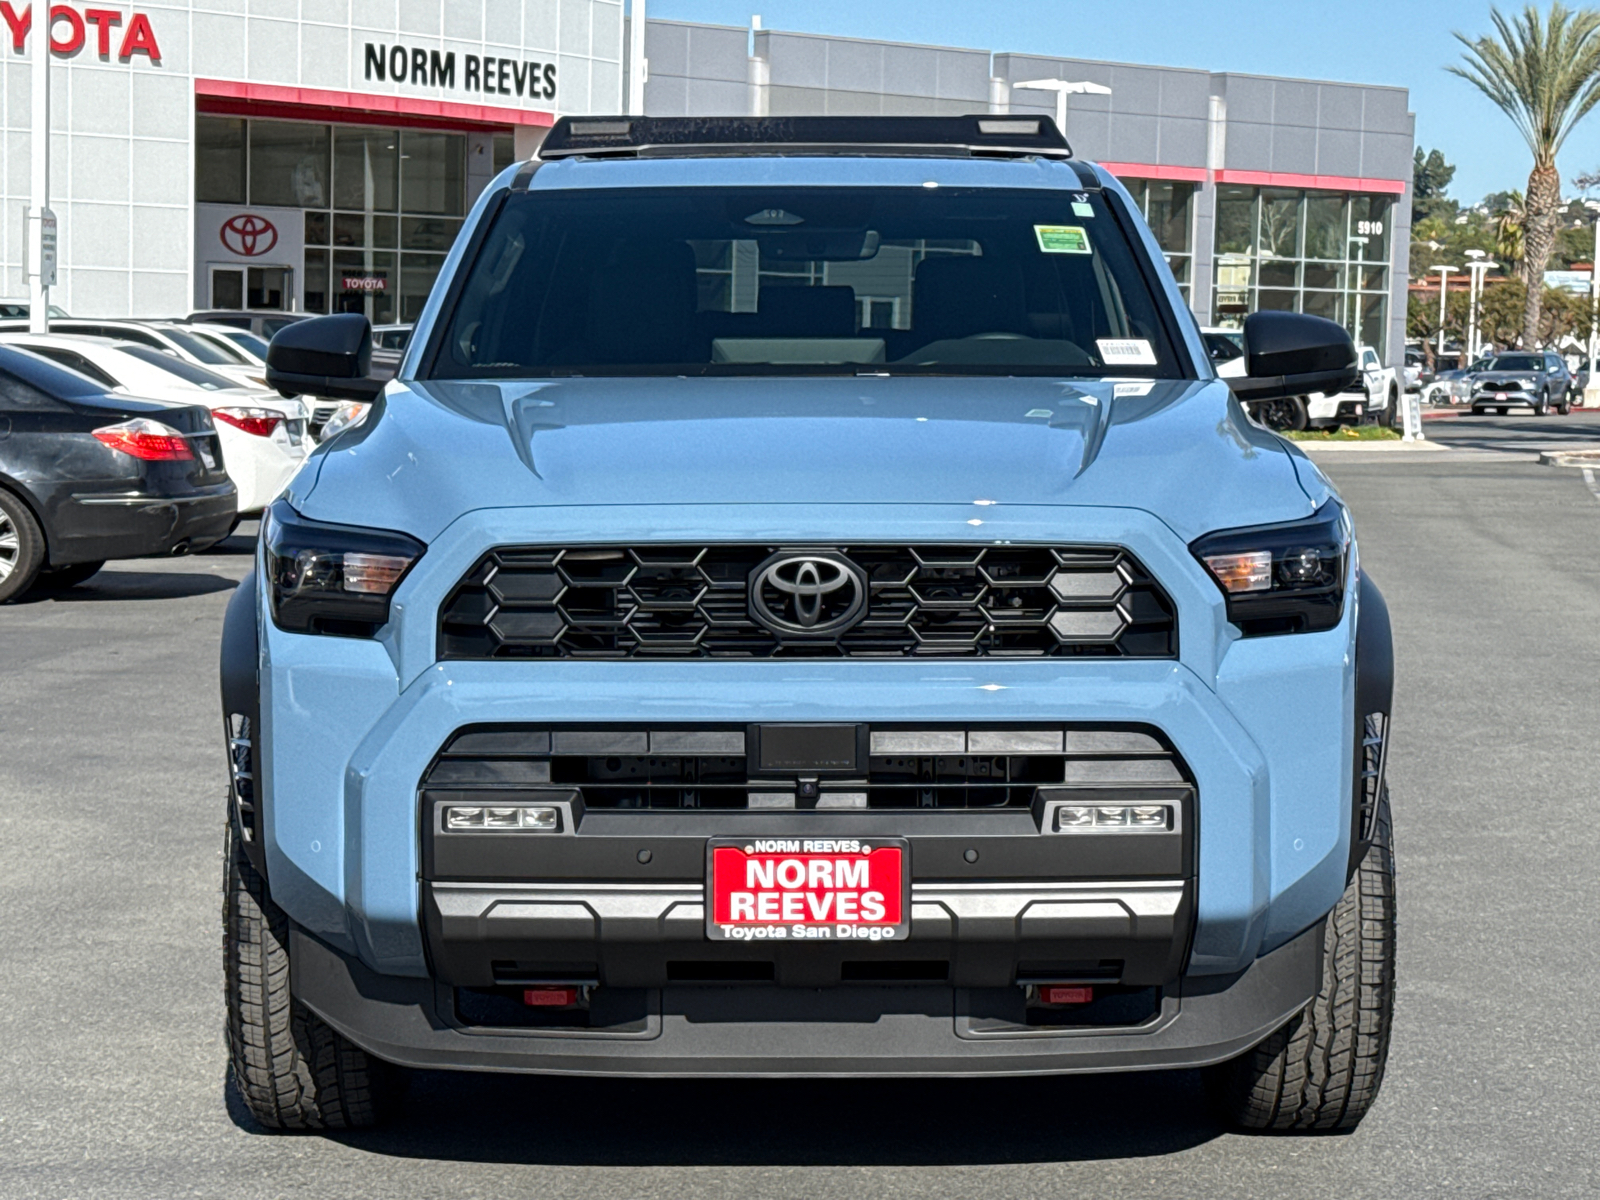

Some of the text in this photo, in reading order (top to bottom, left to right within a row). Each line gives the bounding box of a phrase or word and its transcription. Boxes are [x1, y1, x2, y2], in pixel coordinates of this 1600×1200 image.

[365, 43, 556, 101] NORM REEVES
[1358, 220, 1383, 235] 5910
[345, 278, 384, 289] TOYOTA
[755, 840, 860, 853] NORM REEVES
[746, 859, 870, 889] NORM
[730, 891, 886, 921] REEVES
[720, 924, 895, 940] Toyota San Diego
